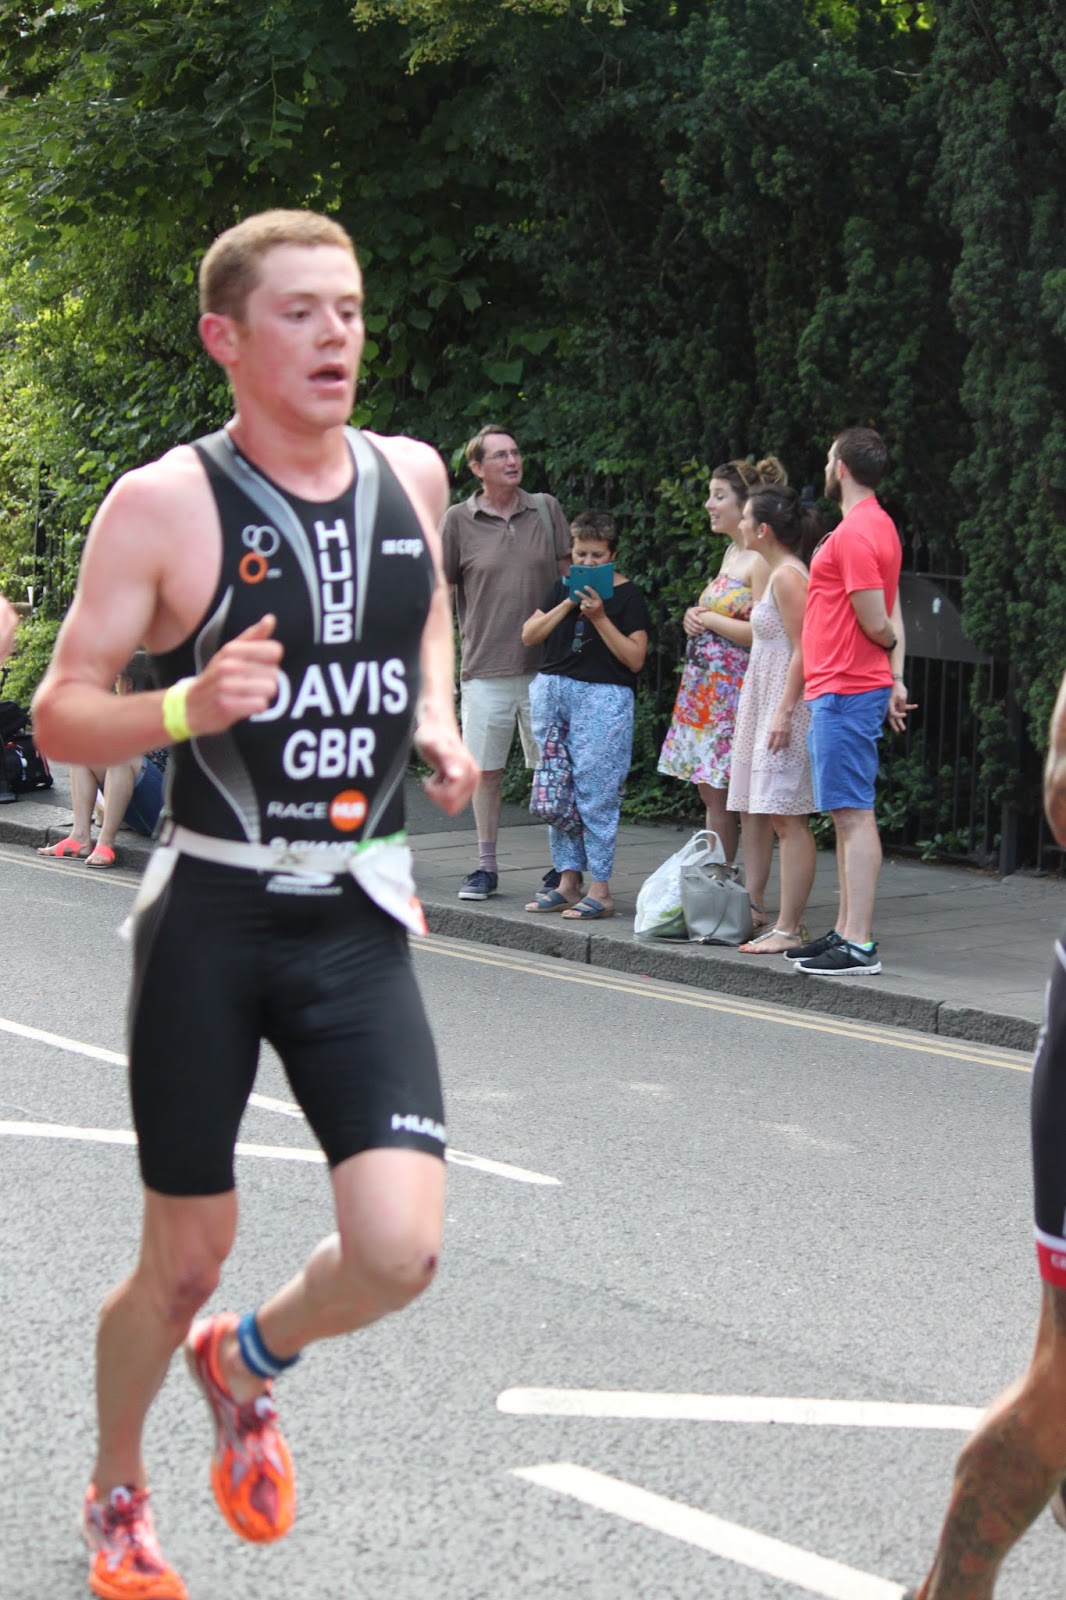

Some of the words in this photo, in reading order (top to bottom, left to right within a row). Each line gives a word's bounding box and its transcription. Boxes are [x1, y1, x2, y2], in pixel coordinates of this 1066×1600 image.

[314, 518, 354, 644] HUUB
[282, 727, 376, 780] GBR
[266, 801, 328, 820] RACE
